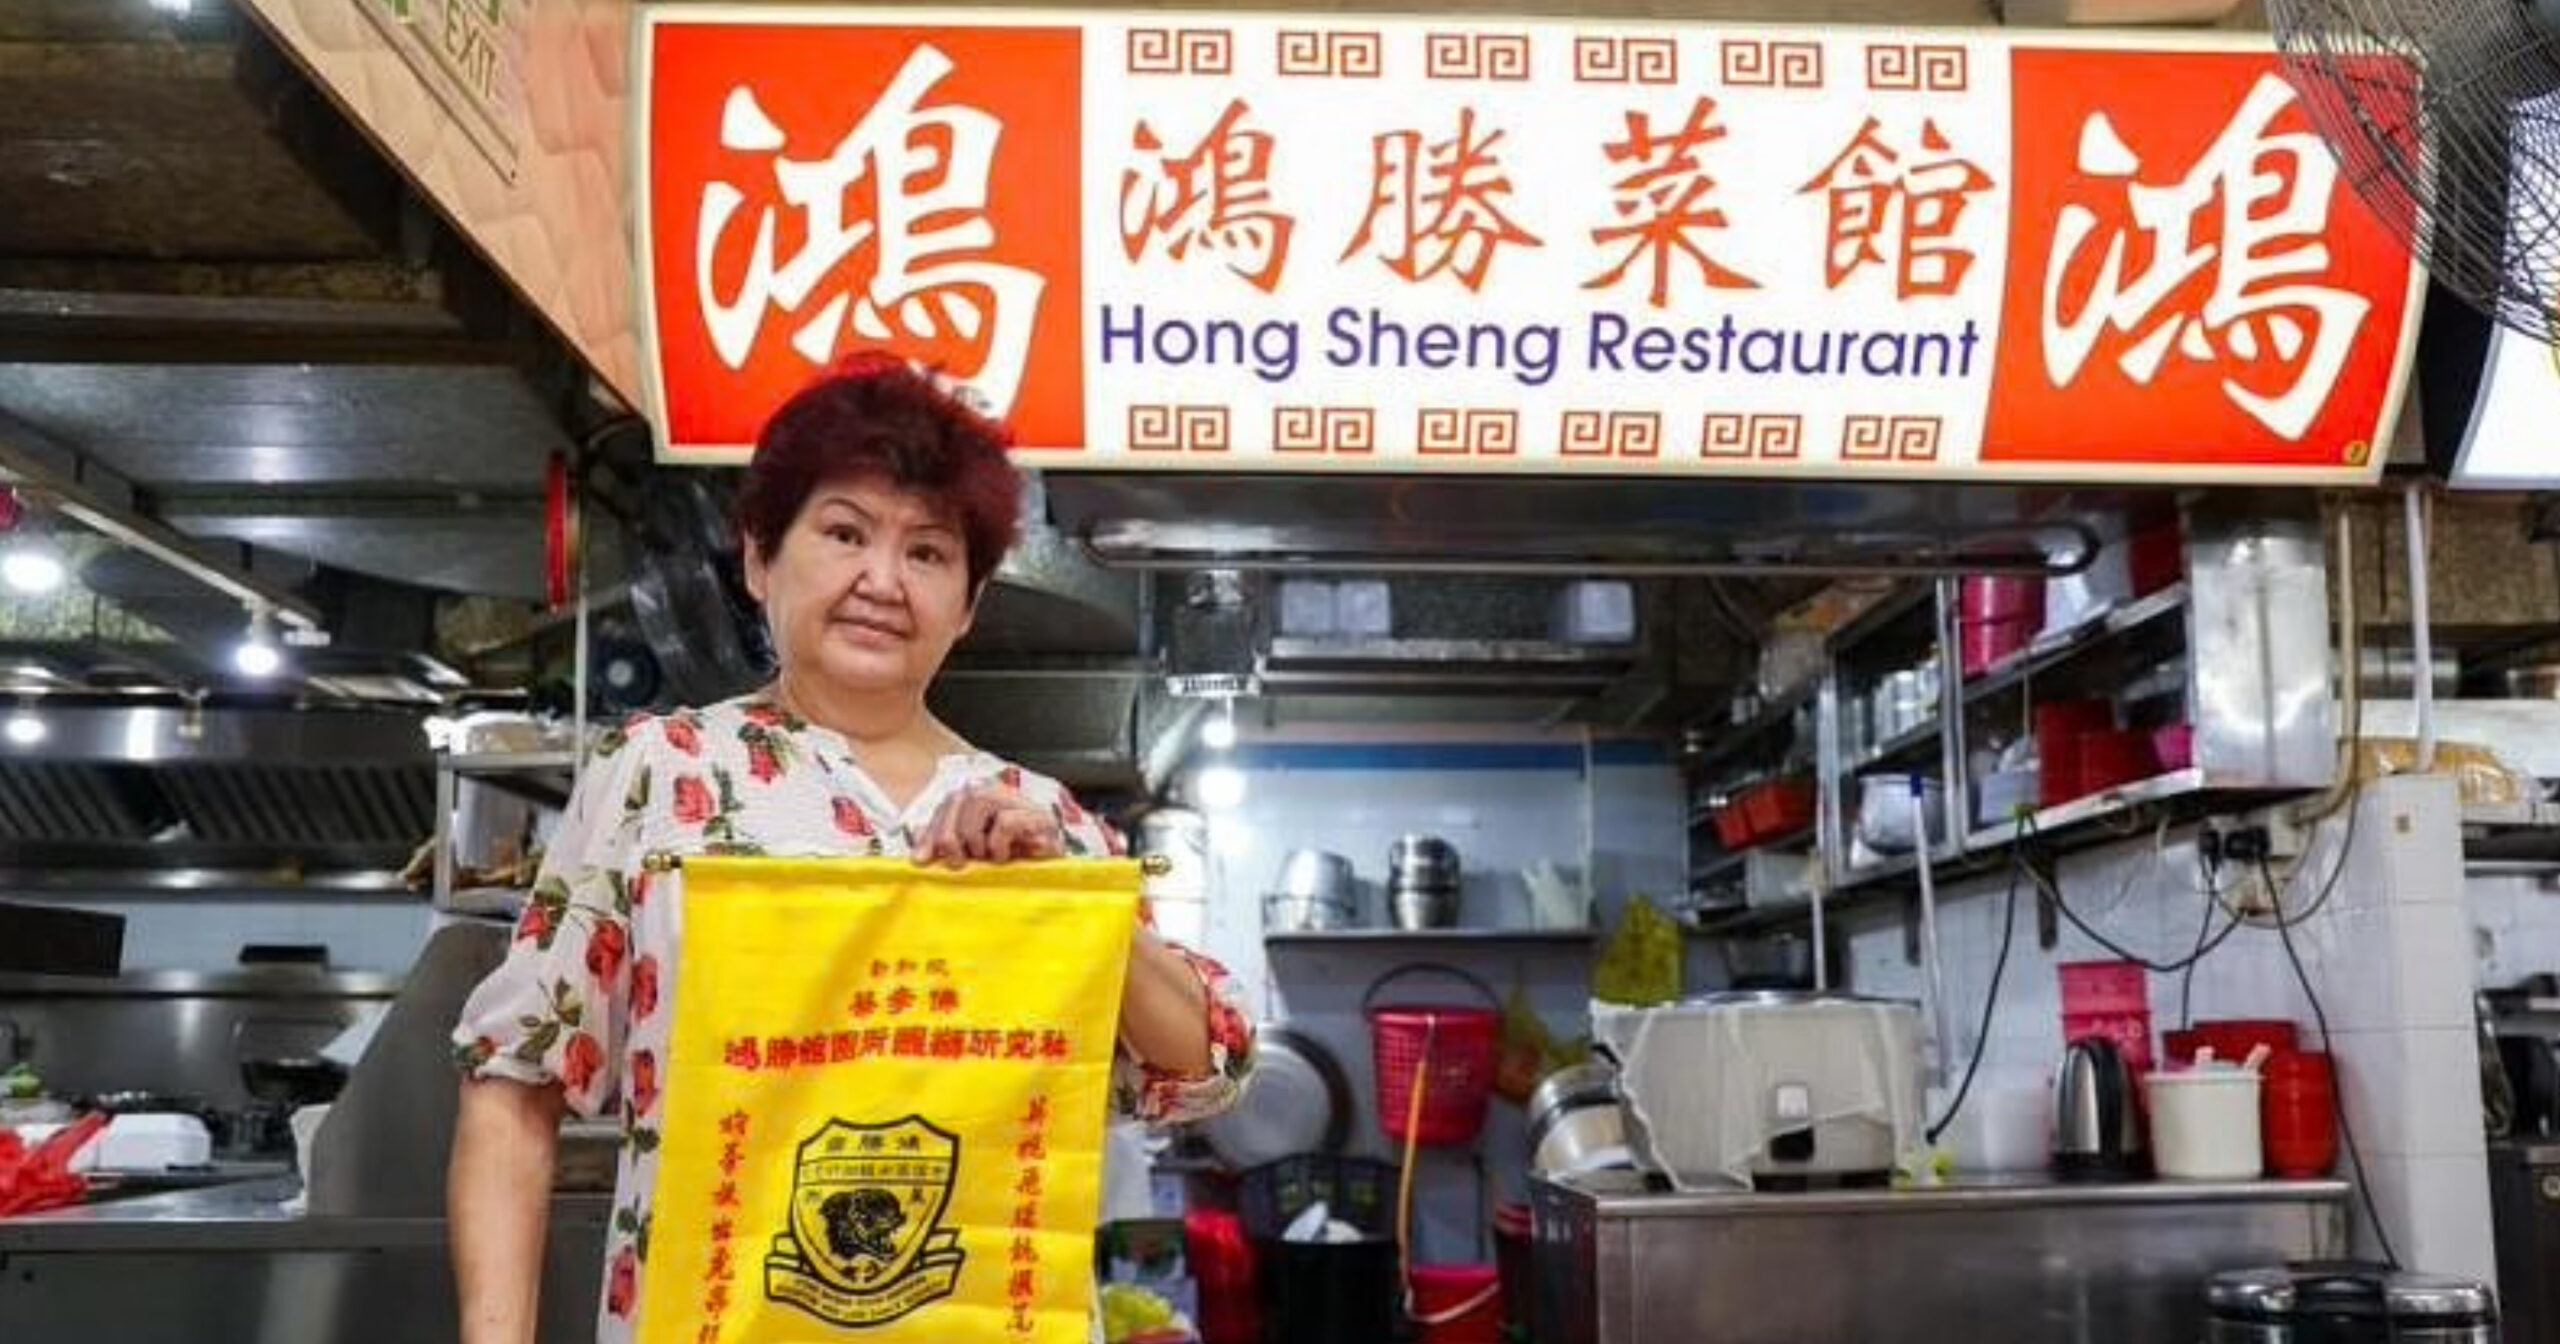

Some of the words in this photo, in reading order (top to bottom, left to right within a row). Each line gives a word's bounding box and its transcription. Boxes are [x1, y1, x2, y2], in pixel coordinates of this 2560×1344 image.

[445, 0, 496, 99] EXIT
[696, 43, 1047, 416] 鴻
[1119, 96, 1996, 308] 鴻勝菜館
[2042, 73, 2371, 441] 鴻
[1101, 306, 1300, 383] Hong
[1326, 308, 1561, 386] Sheng
[1589, 313, 1980, 378] Restaurant
